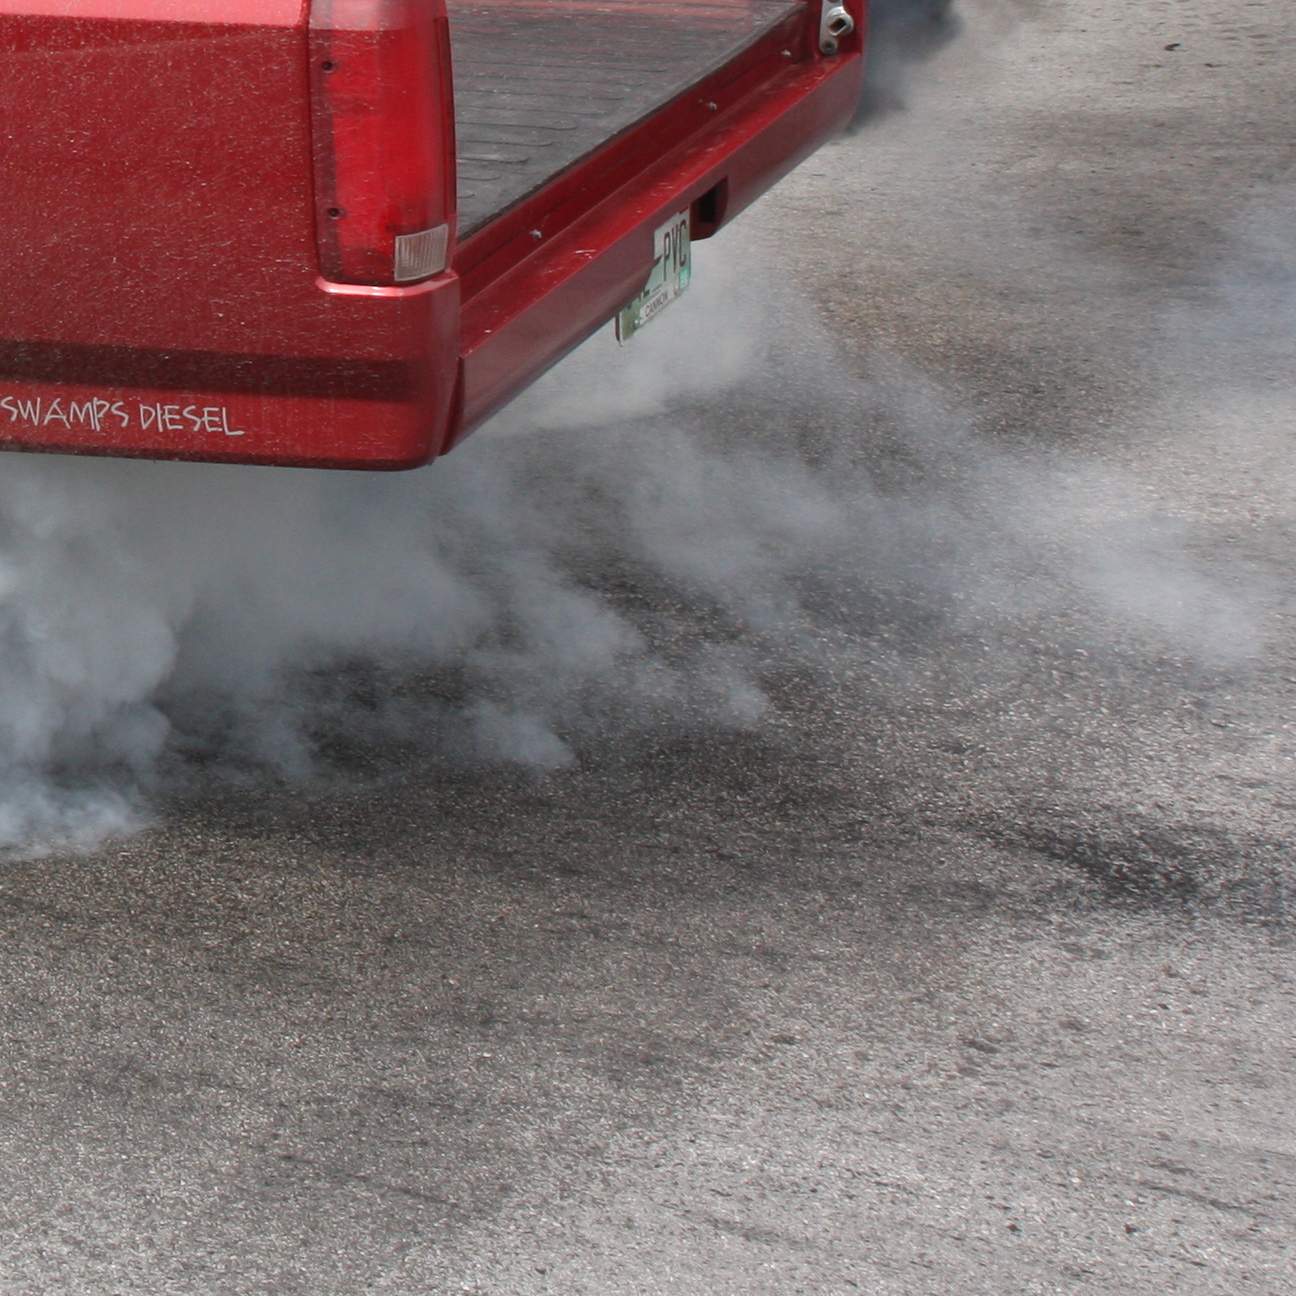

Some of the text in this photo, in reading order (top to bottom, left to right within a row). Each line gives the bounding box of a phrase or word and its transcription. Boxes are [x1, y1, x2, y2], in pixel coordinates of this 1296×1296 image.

[663, 218, 688, 283] PVC
[0, 396, 246, 436] SWAMPS DIESEL
